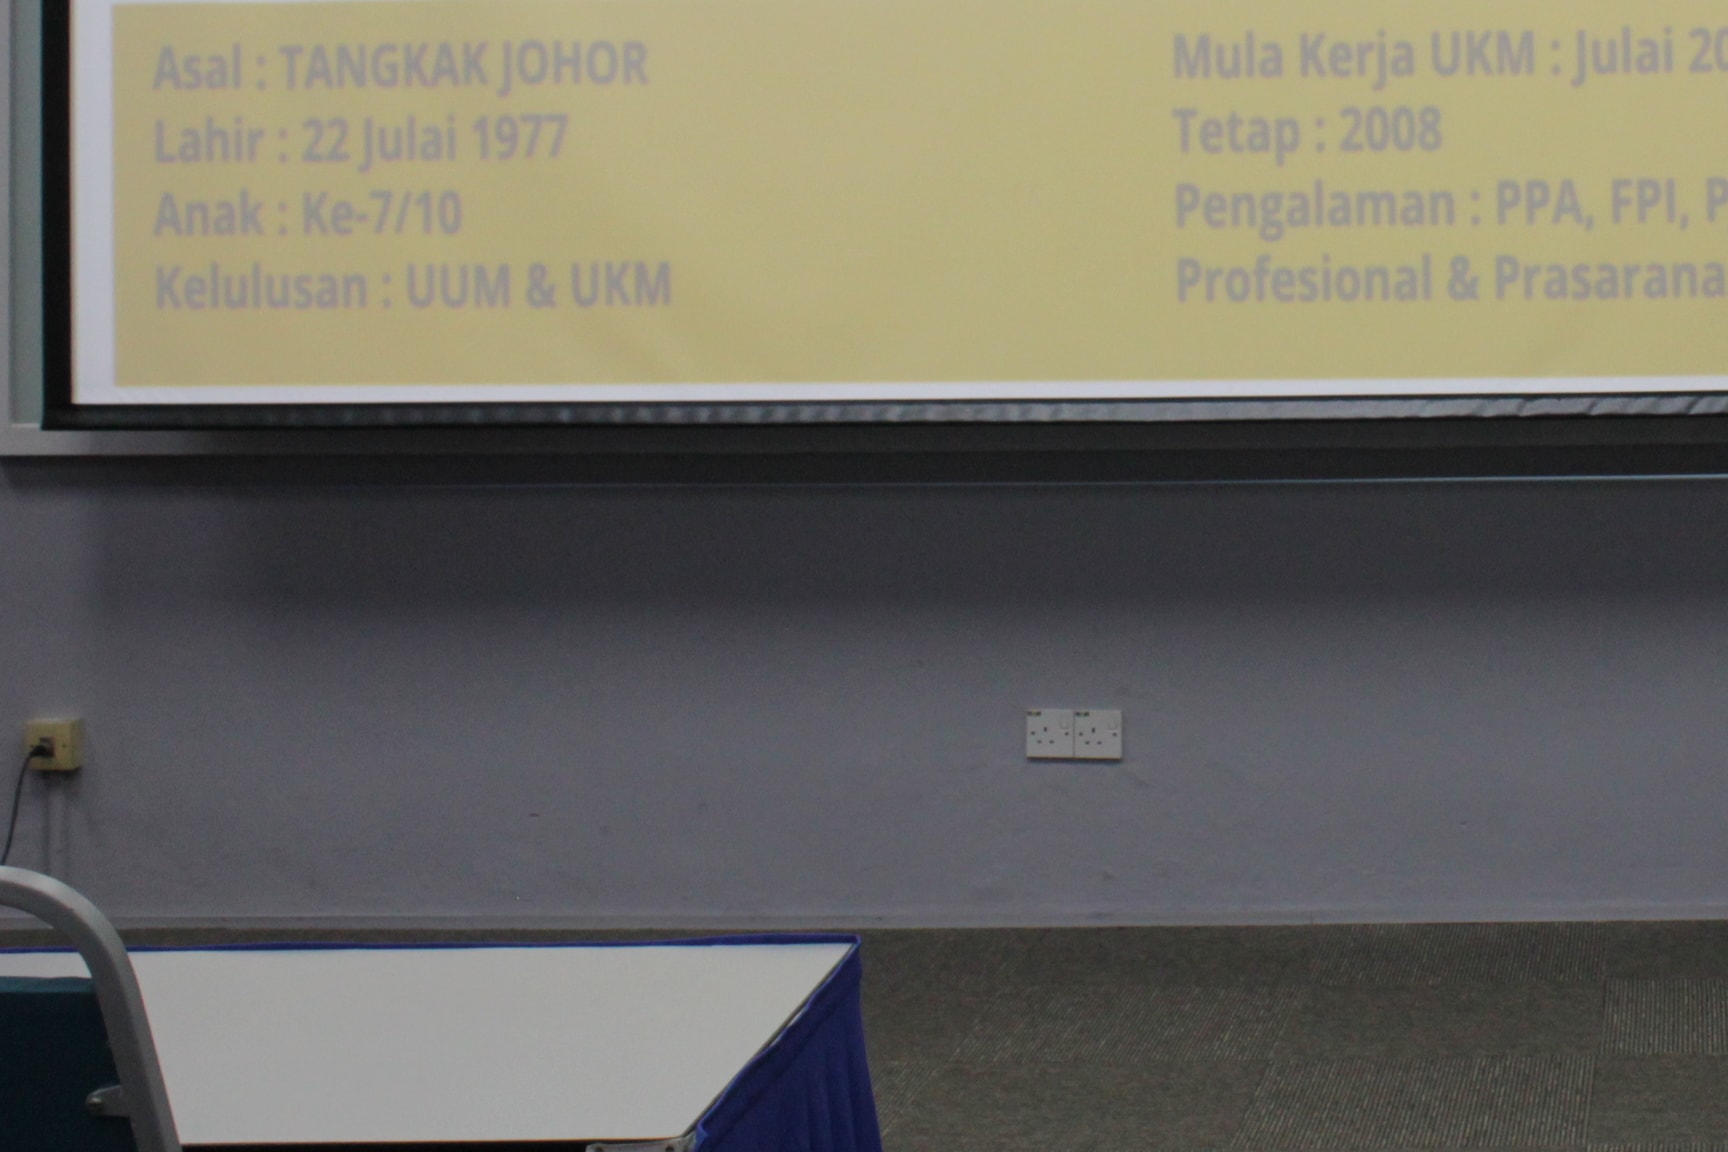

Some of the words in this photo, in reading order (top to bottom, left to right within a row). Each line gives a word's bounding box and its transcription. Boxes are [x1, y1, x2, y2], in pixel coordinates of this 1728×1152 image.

[153, 43, 242, 90] Asal
[256, 55, 266, 90] :
[279, 42, 489, 89] TANGKAK
[497, 40, 648, 97] JOHOR
[1172, 30, 1283, 80] Mula
[1300, 28, 1416, 90] Kerja
[1431, 29, 1535, 77] UKM
[1550, 41, 1561, 77] :
[1571, 25, 1675, 87] Julai
[154, 117, 265, 164] Lahir
[278, 128, 288, 162] :
[302, 118, 348, 162] 22
[359, 115, 456, 173] Julai
[472, 114, 569, 161] 1977
[1172, 105, 1301, 166] Tetap
[1314, 120, 1325, 153] :
[1340, 106, 1442, 153] 2008
[153, 189, 263, 237] Anak
[278, 201, 288, 236] :
[302, 190, 461, 236] Ke-7/10
[1175, 177, 1456, 241] Pengalaman
[1470, 191, 1481, 226] :
[1496, 179, 1595, 231] PPA,
[1610, 178, 1690, 230] FPI,
[156, 263, 367, 309] Kelulusan
[382, 273, 391, 308] :
[406, 264, 511, 309] UUM
[526, 262, 555, 308] &
[571, 261, 671, 307] UKM
[1178, 253, 1433, 303] Profesional
[1448, 254, 1480, 302] &
